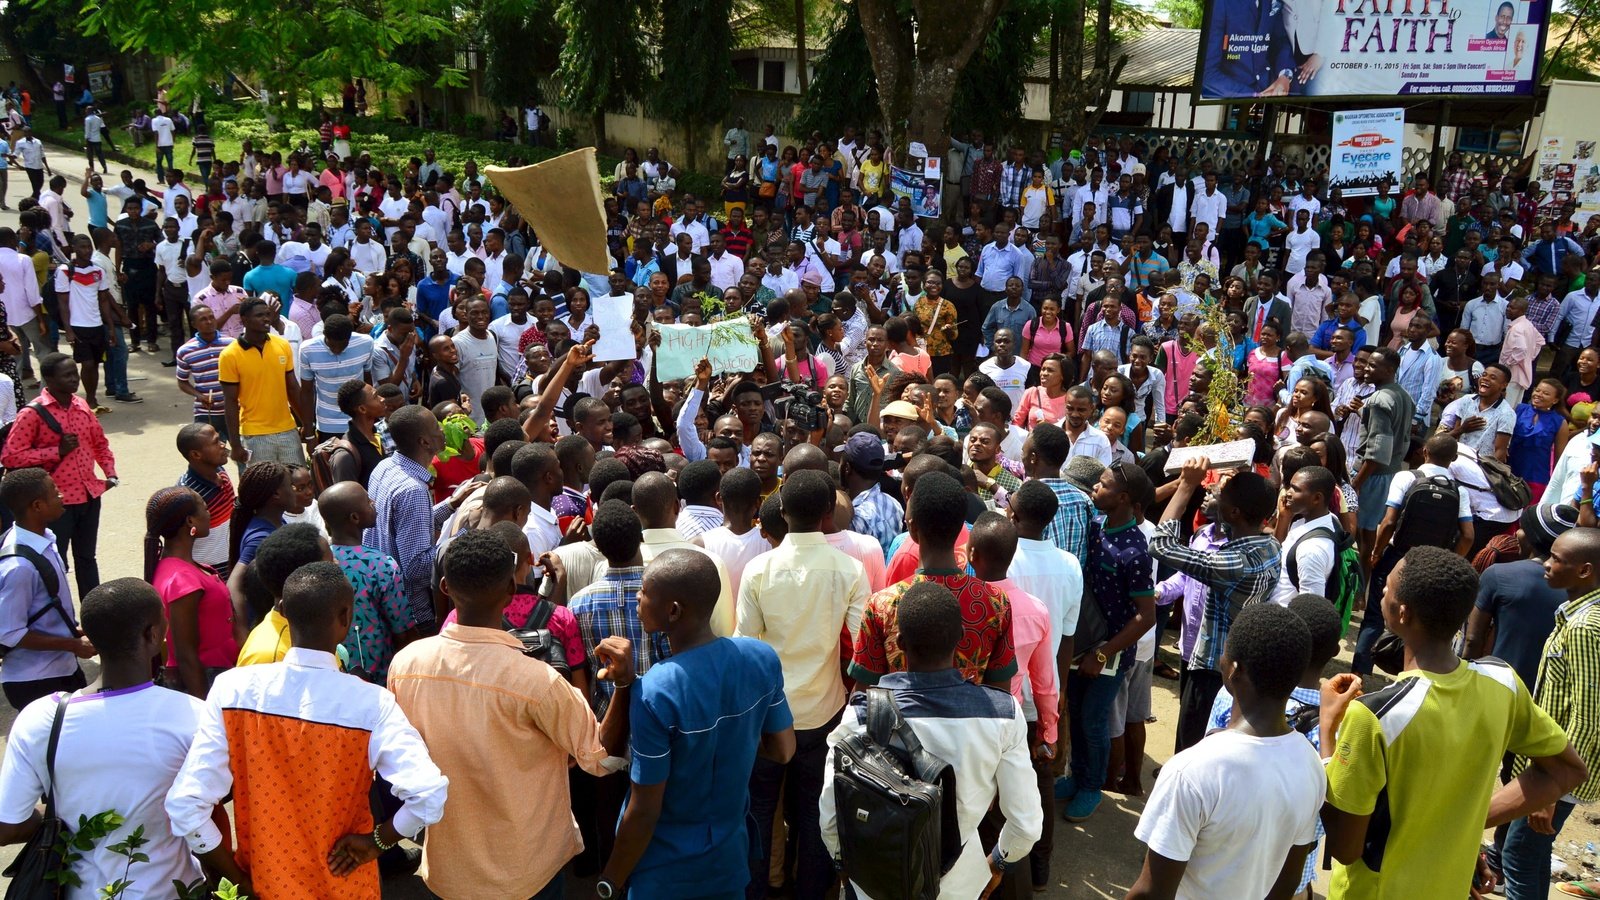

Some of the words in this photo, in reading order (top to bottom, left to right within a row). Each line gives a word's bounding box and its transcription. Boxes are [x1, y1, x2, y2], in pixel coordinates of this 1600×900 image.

[1229, 34, 1264, 43] Akomaye
[1264, 33, 1271, 41] &
[1341, 17, 1456, 53] FAITH
[1228, 44, 1250, 52] Kome
[1330, 62, 1363, 70] OCTOBER
[1363, 62, 1369, 70] 9
[1384, 62, 1400, 70] 2015
[1401, 71, 1419, 79] Sunday
[1409, 85, 1419, 94] For
[1341, 152, 1391, 164] Eyecare
